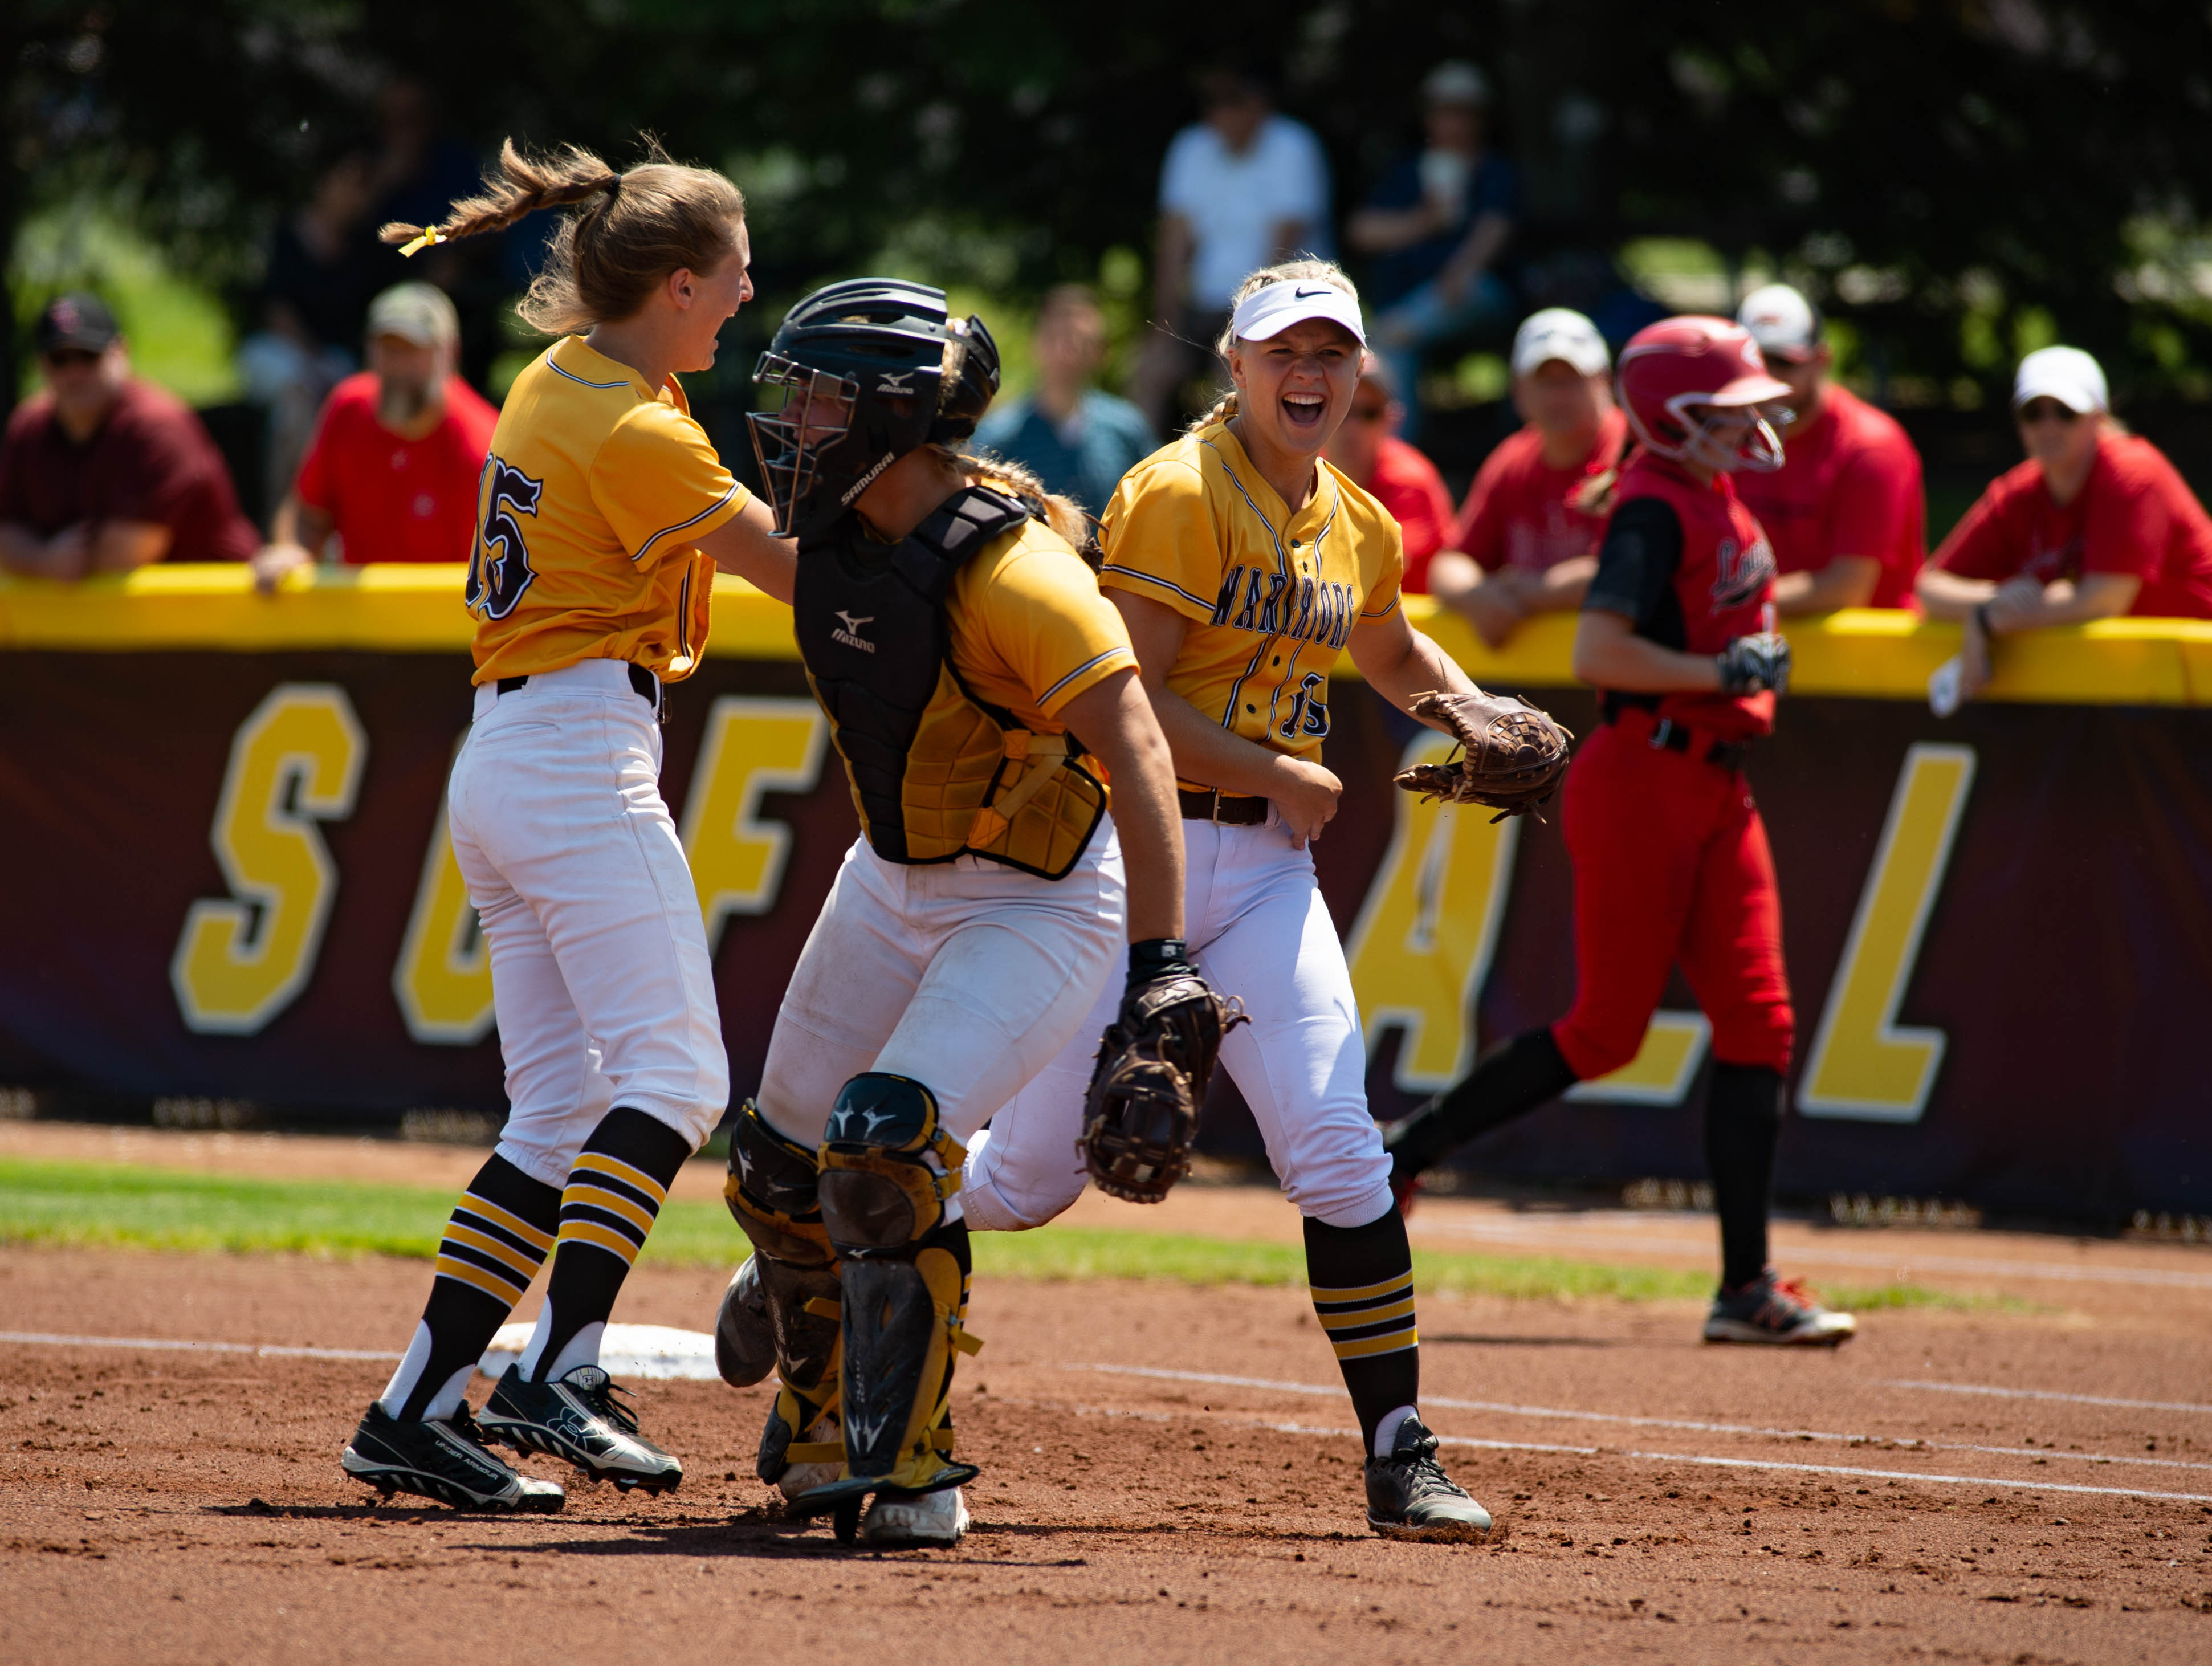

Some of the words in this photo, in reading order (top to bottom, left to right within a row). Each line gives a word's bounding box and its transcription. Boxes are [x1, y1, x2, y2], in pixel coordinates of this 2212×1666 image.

[841, 451, 895, 506] SAMURAI
[435, 1440, 463, 1460] UNDER
[463, 1459, 499, 1480] ARMOUR
